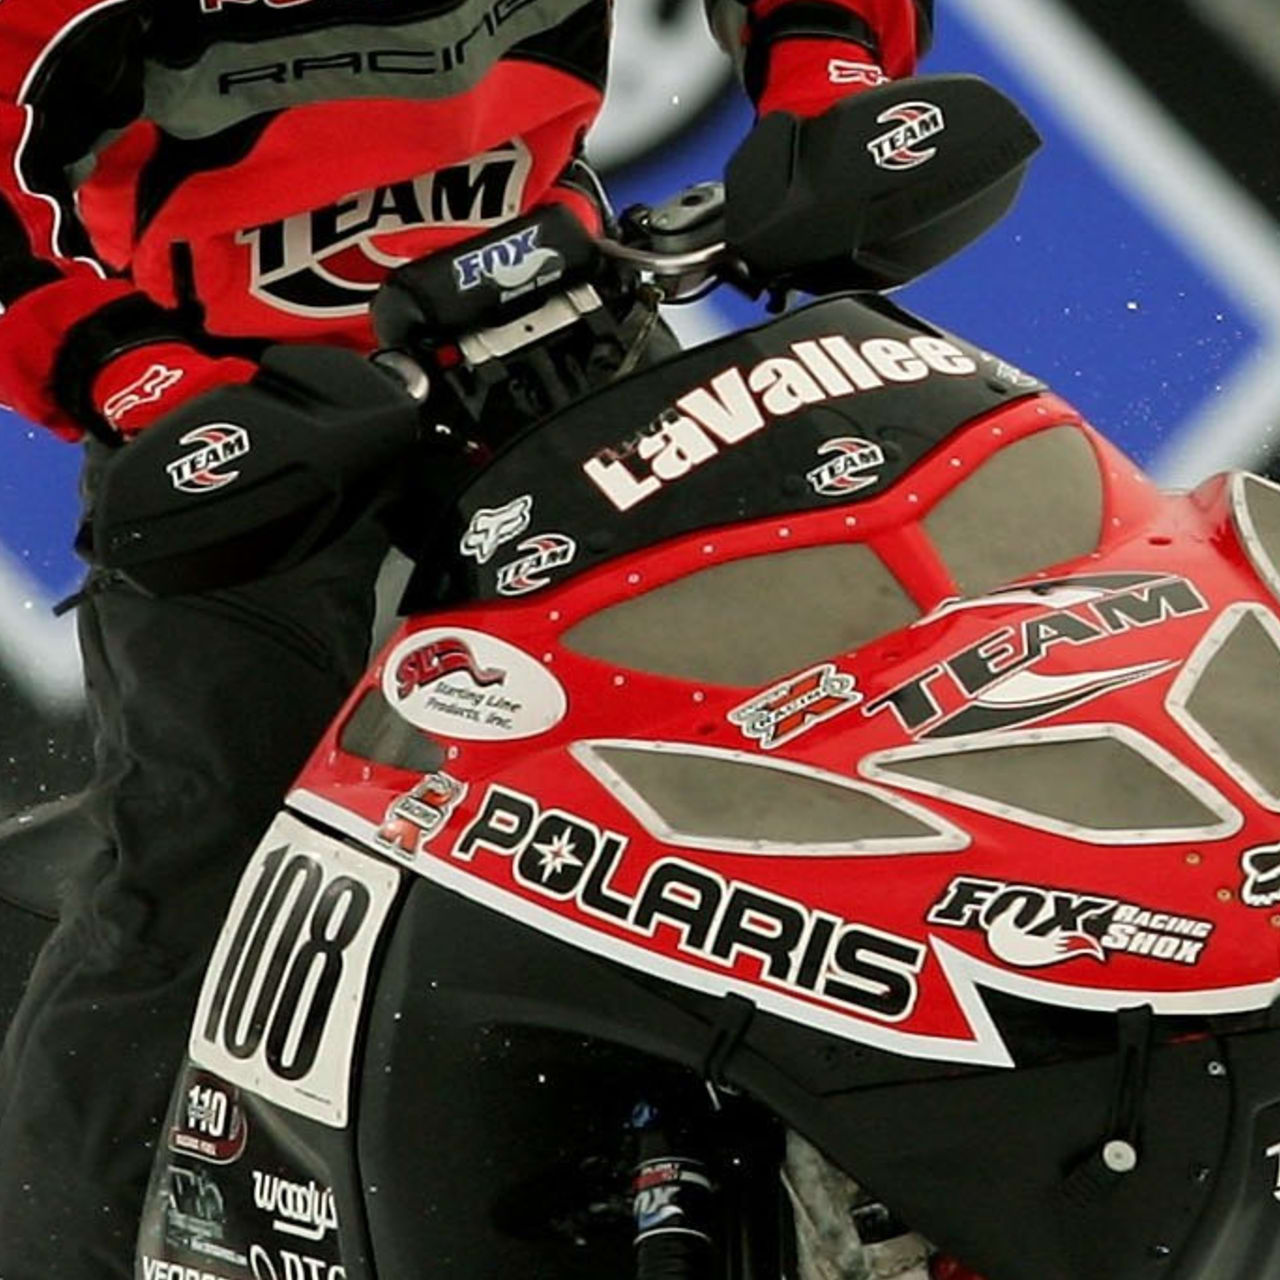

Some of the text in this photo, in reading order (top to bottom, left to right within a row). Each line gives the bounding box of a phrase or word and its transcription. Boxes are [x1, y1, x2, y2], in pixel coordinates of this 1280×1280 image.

[871, 111, 944, 161] TEAM
[238, 138, 523, 278] TEAM
[452, 224, 540, 291] FOX
[583, 335, 978, 511] LaVallee
[170, 433, 246, 483] TEAM
[809, 447, 880, 488] TEAM
[866, 575, 1209, 734] TEAM
[454, 785, 927, 1022] POLARIS
[929, 877, 1213, 938] FOX RACING
[203, 842, 371, 1081] 108
[1101, 923, 1204, 964] SHOX
